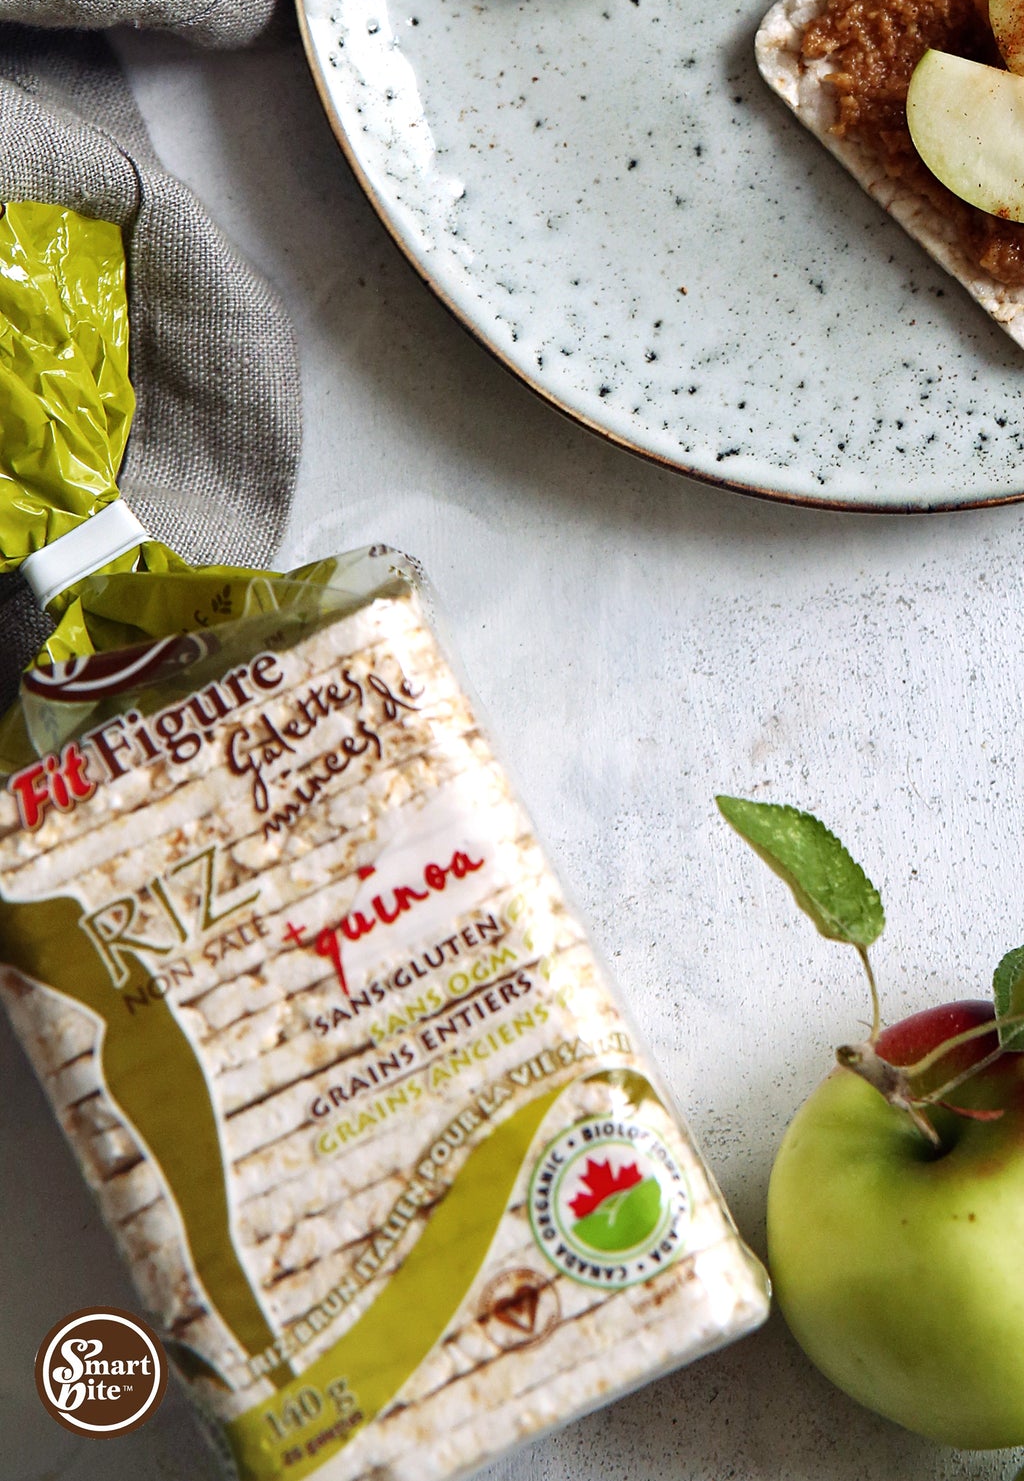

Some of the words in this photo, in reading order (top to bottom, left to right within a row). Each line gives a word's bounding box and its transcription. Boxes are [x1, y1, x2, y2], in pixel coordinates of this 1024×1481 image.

[10, 742, 96, 830] Fit
[86, 651, 285, 780] Figure
[227, 669, 363, 813] Galettes
[262, 720, 382, 840] minces
[366, 673, 426, 721] de
[79, 845, 261, 989] RIZ
[122, 958, 194, 1015] NON
[313, 981, 386, 1036] SANS
[393, 913, 501, 989] GLUTEN
[310, 1043, 416, 1118] GRAINS
[419, 972, 533, 1052] ENTIERS
[369, 988, 443, 1044] SANS
[447, 946, 519, 996] OGM
[315, 1077, 424, 1155] GRAINS
[428, 1002, 551, 1089] ANCIENS
[353, 1177, 430, 1285] ITALIEN
[416, 1107, 482, 1182] POUR
[476, 1082, 514, 1121] LA
[534, 1151, 564, 1241] ORGANIC
[555, 1242, 629, 1281] CANADA
